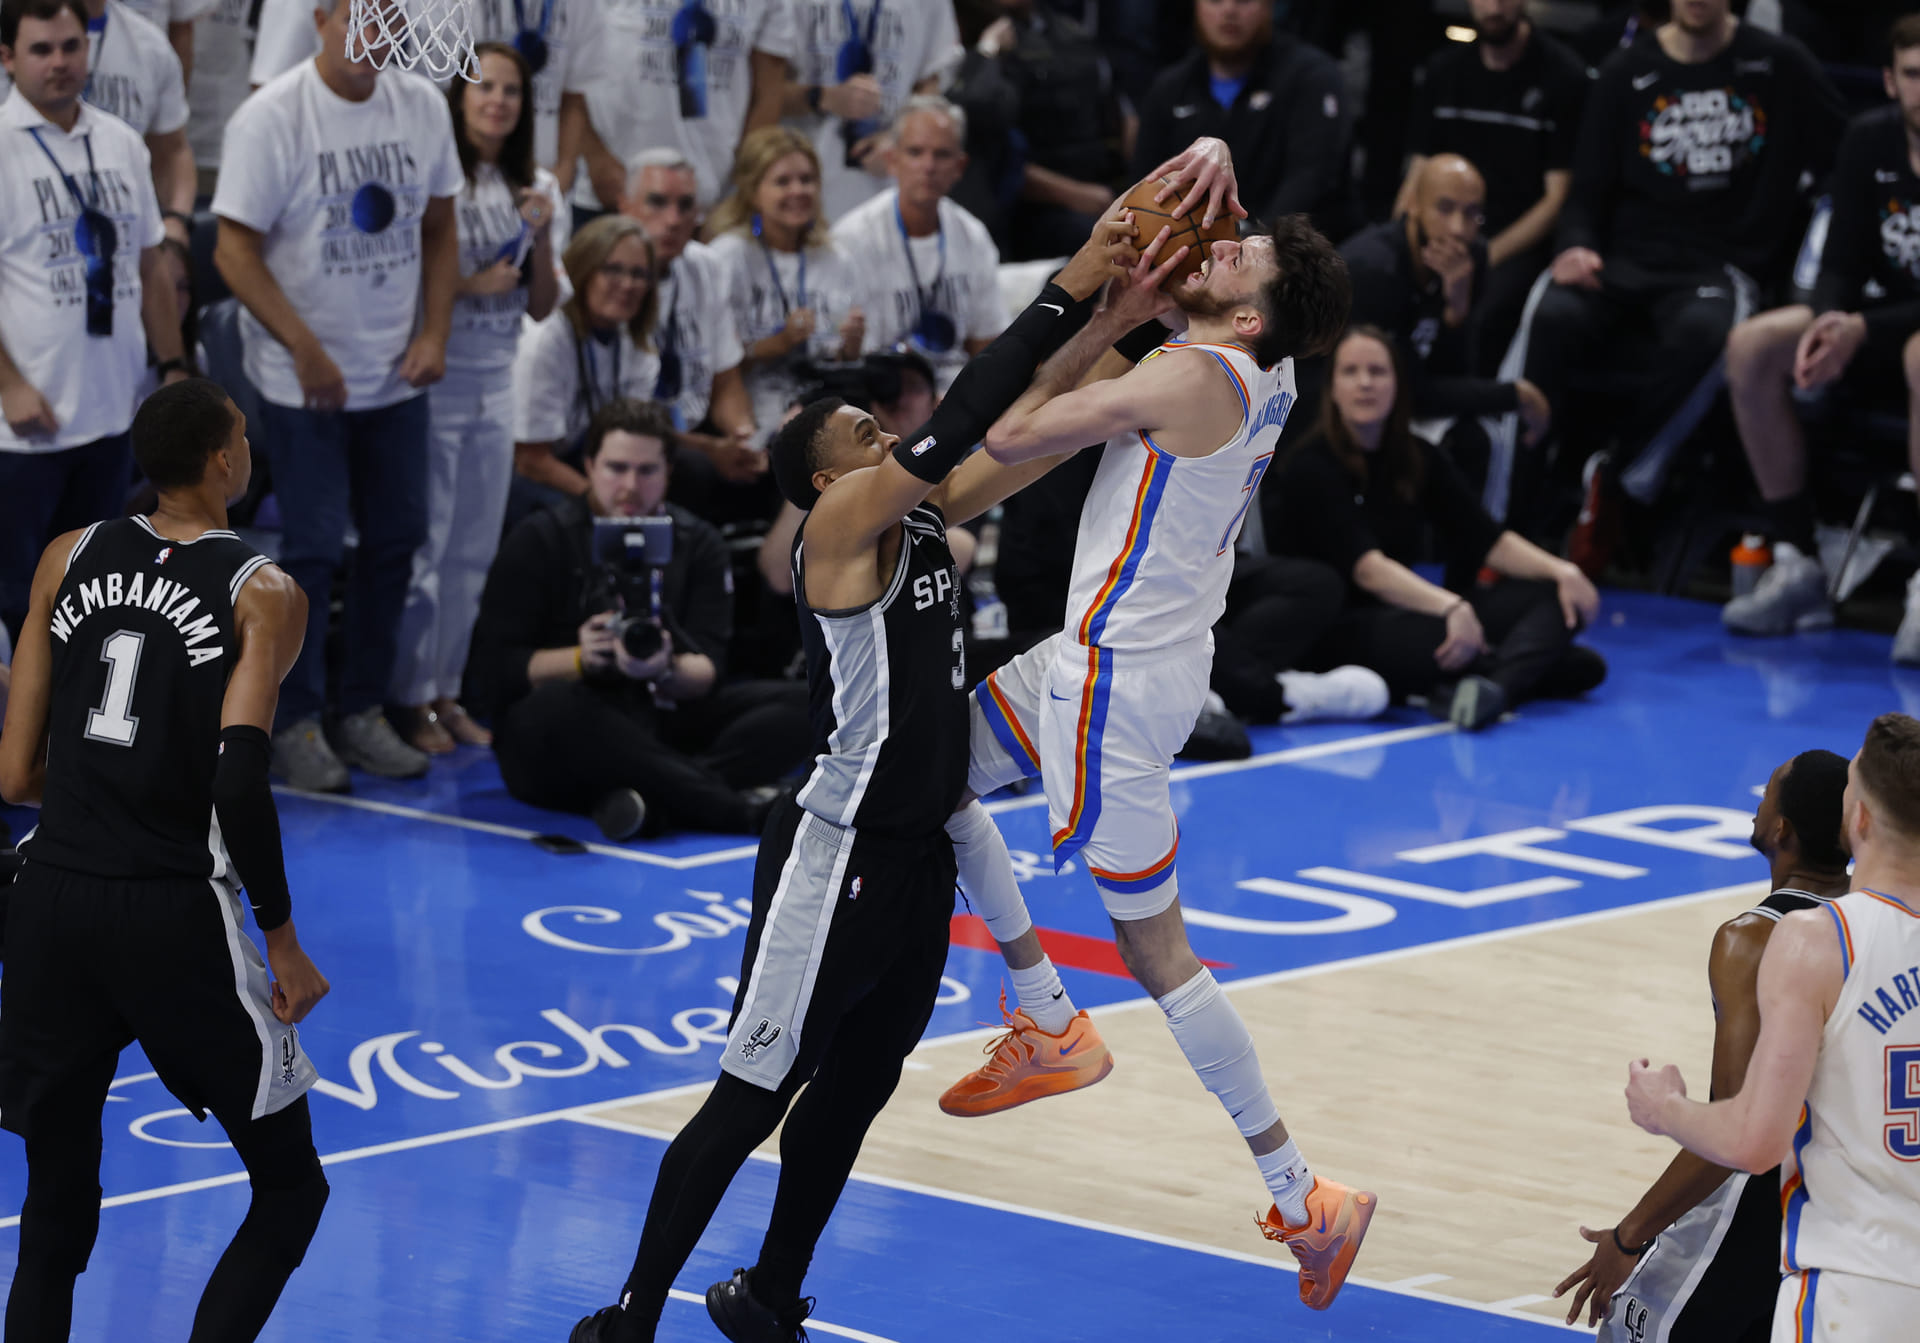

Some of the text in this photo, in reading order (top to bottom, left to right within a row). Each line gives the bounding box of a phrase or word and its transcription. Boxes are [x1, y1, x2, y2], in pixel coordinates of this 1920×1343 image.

[1216, 450, 1276, 557] 7
[50, 571, 224, 668] WEMBANYAMA
[83, 628, 147, 748] 1
[1180, 784, 1766, 935] ULTR
